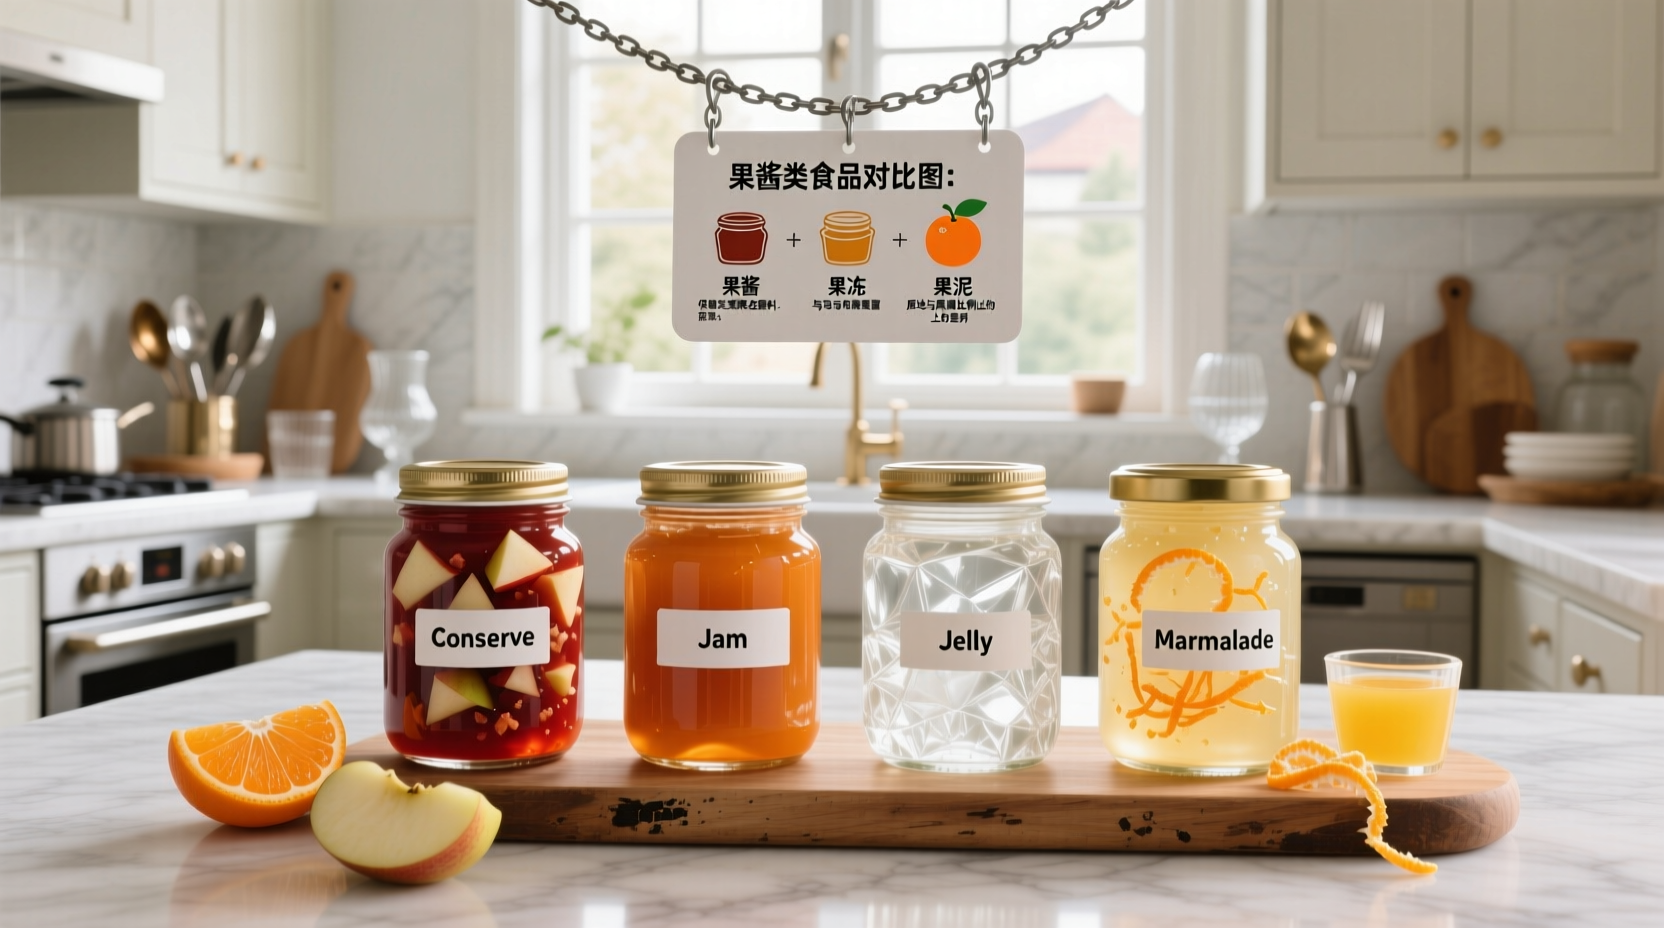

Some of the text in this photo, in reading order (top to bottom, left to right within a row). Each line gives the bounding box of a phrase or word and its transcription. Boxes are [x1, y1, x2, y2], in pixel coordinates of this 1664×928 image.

[722, 275, 761, 297] 果酱
[828, 276, 867, 297] 果冻
[934, 276, 973, 297] 果泥
[431, 626, 535, 649] Conserve
[698, 628, 748, 649] Jam
[939, 628, 993, 656] Jelly
[1154, 628, 1274, 651] Marmalade
